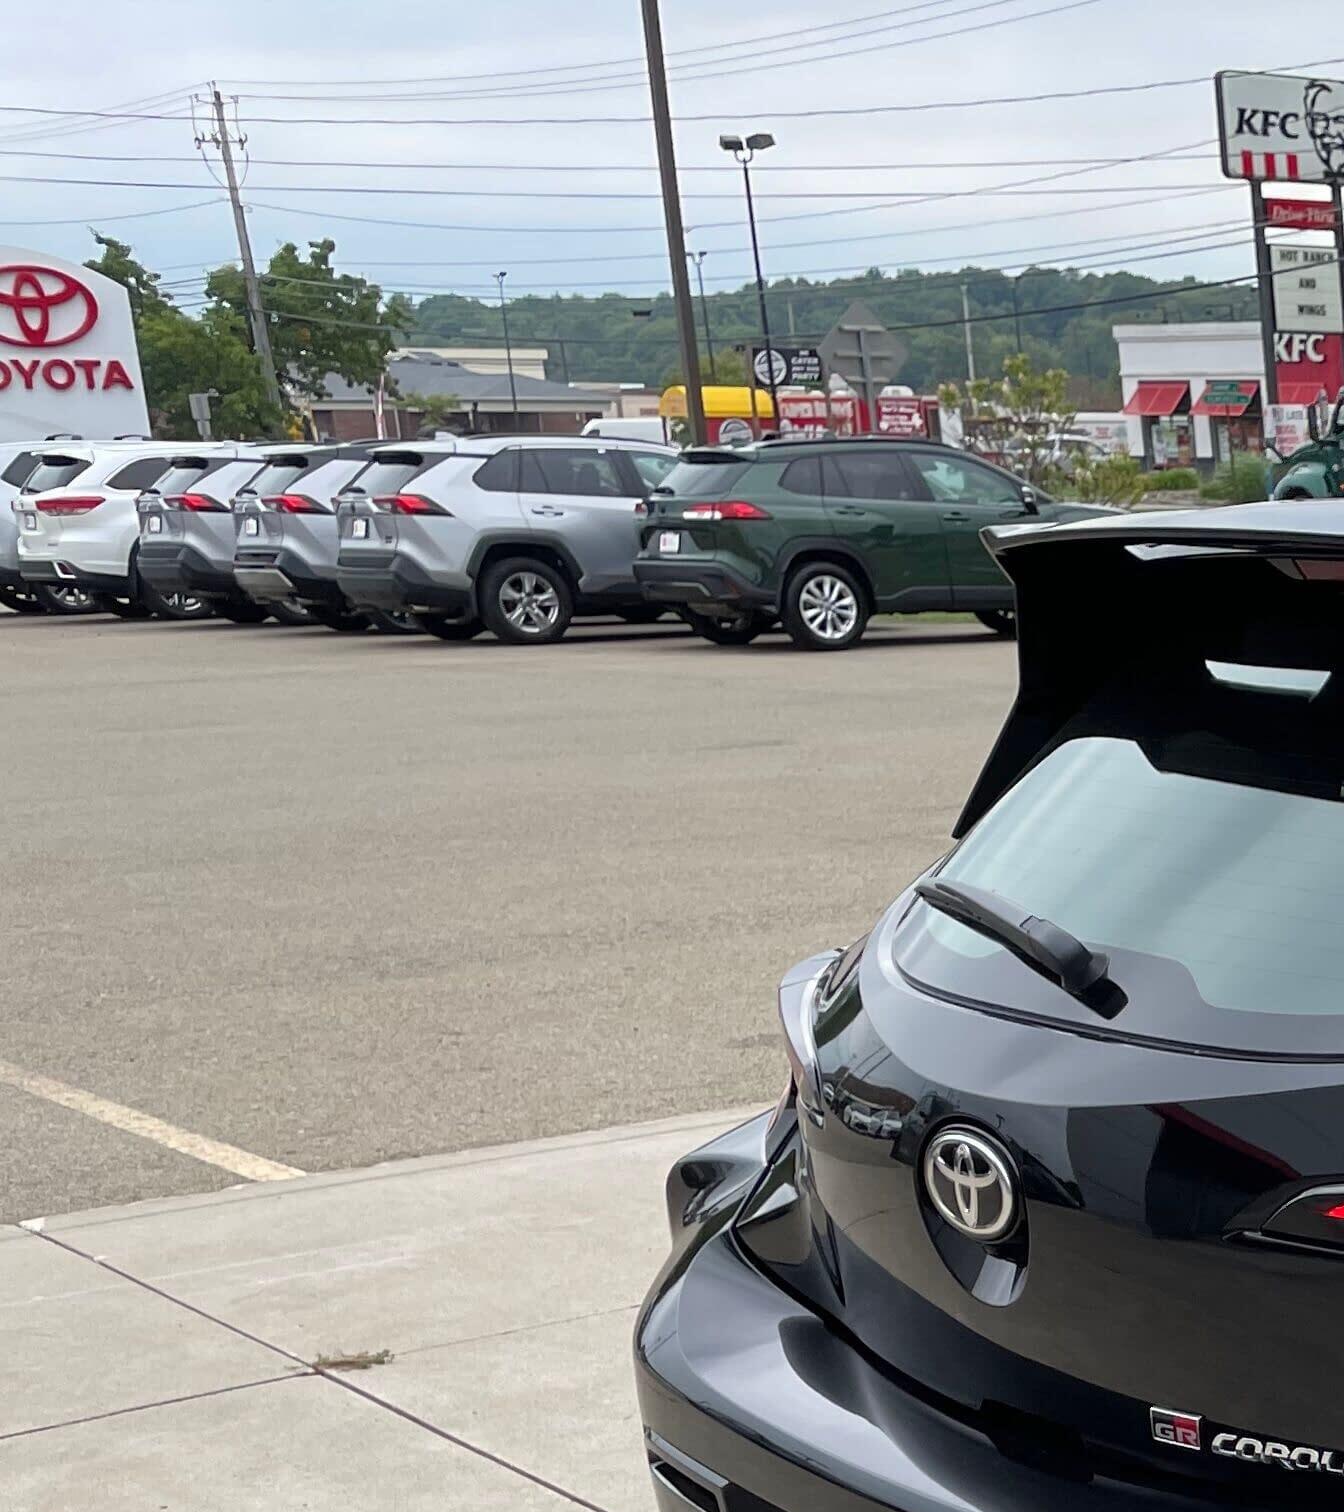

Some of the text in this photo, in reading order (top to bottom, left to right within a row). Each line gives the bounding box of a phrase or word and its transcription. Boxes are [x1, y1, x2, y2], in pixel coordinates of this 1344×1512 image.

[1235, 107, 1300, 139] KFC
[1299, 277, 1317, 289] AND
[1273, 331, 1326, 363] KFC
[0, 359, 134, 390] YOTA
[1155, 1424, 1198, 1446] GR
